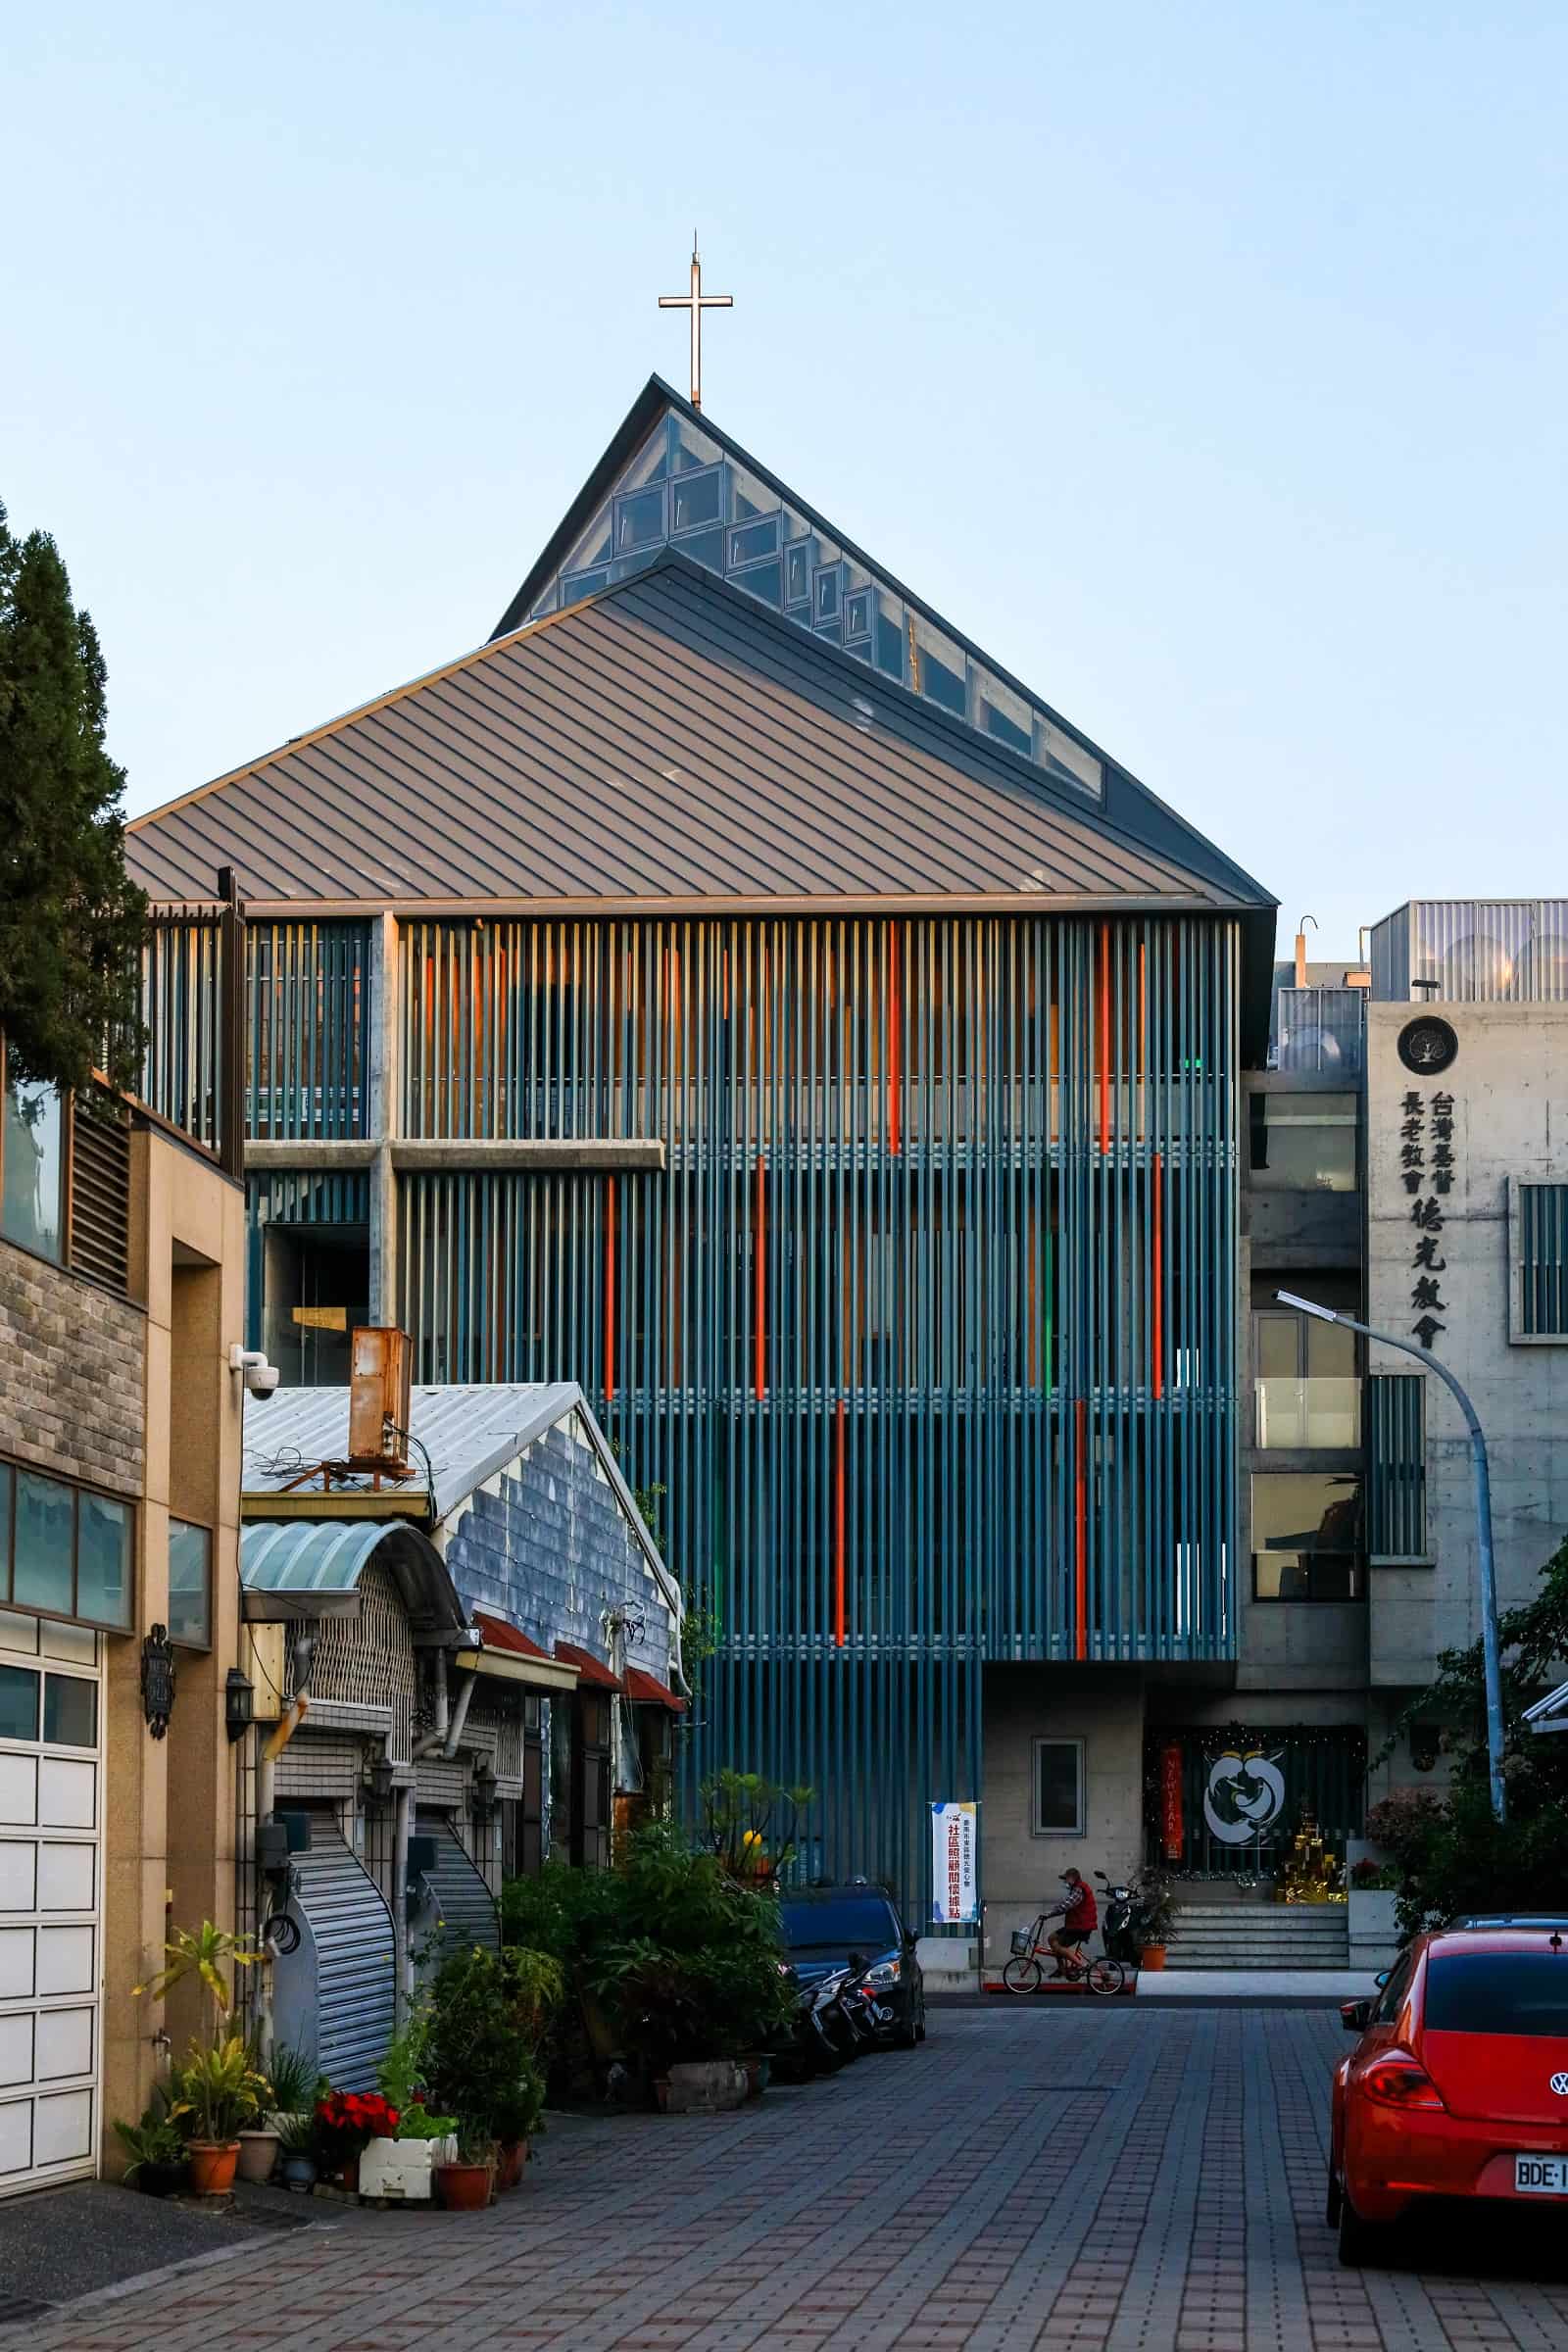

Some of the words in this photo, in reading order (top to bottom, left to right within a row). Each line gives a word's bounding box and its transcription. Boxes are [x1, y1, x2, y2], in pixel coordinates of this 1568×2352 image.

[1400, 1091, 1425, 1194] 長老教會
[1429, 1091, 1455, 1194] 台灣基督
[1410, 1196, 1446, 1349] 德光教會
